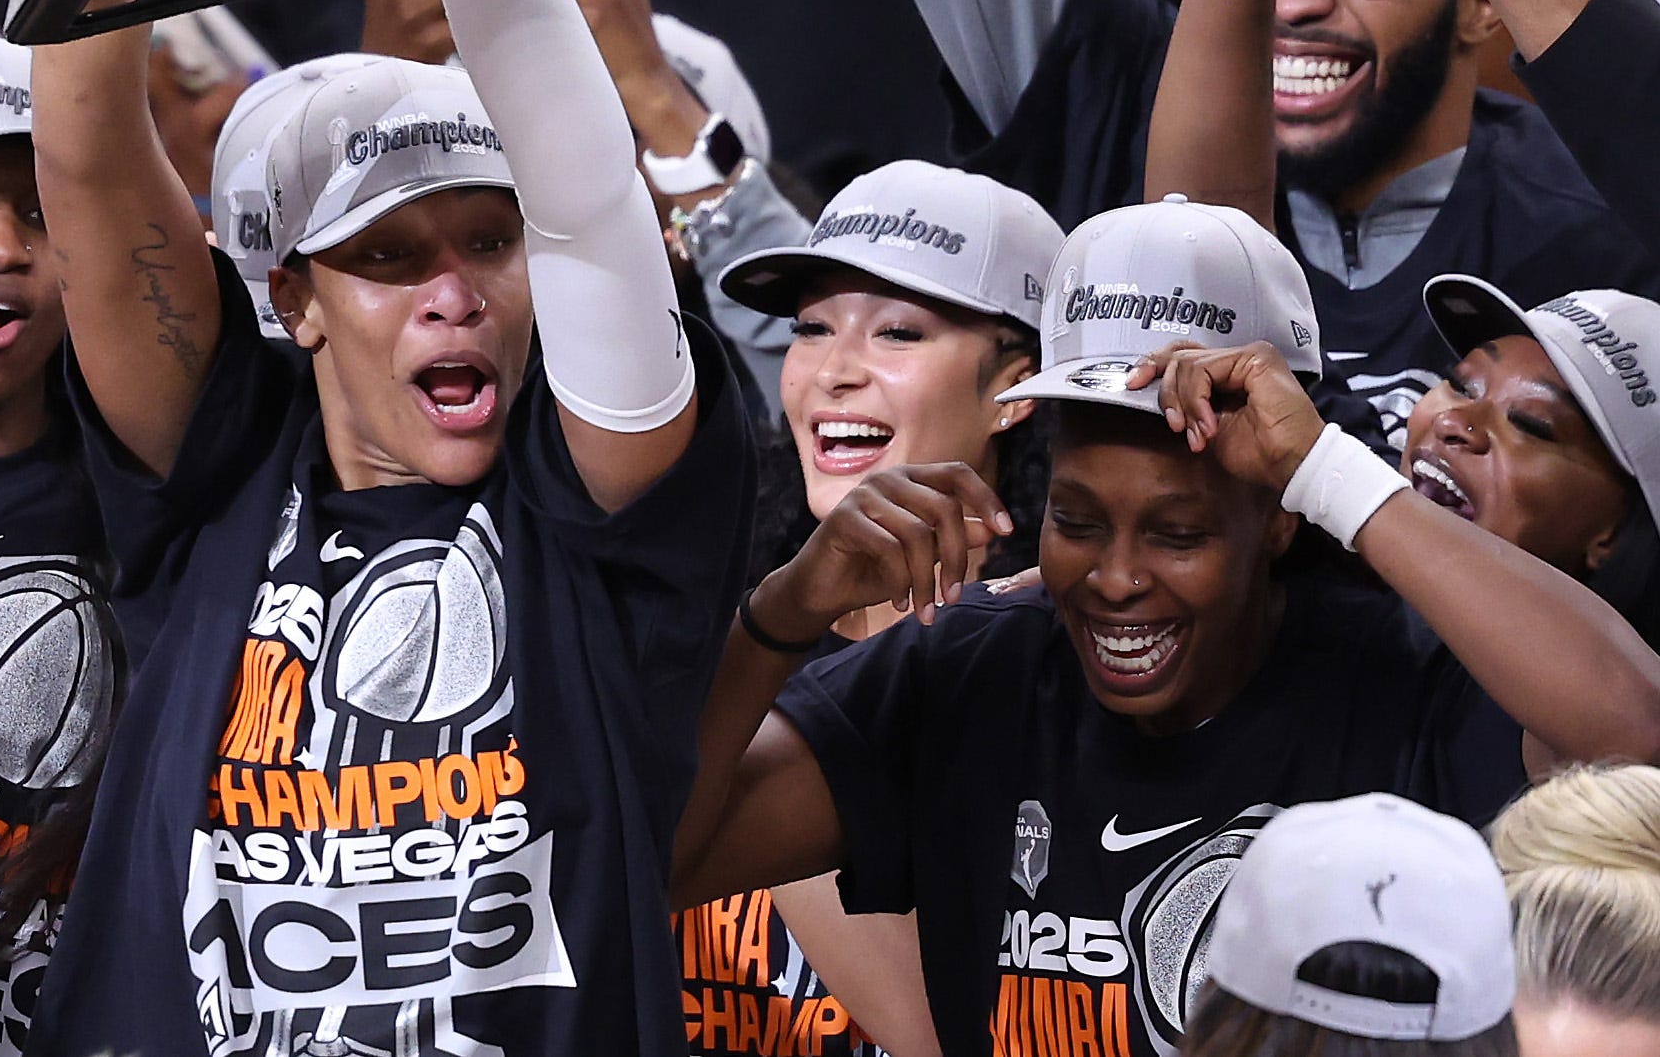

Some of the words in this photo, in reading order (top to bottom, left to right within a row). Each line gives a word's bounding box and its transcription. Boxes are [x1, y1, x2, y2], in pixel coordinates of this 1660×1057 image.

[344, 112, 504, 166] Champion
[1065, 284, 1237, 335] Champions
[1094, 282, 1140, 294] WNBA
[1151, 322, 1191, 336] 2025
[248, 581, 325, 661] 025
[294, 800, 530, 885] VEGAS
[1016, 824, 1050, 840] NALS
[669, 888, 773, 988] NBA
